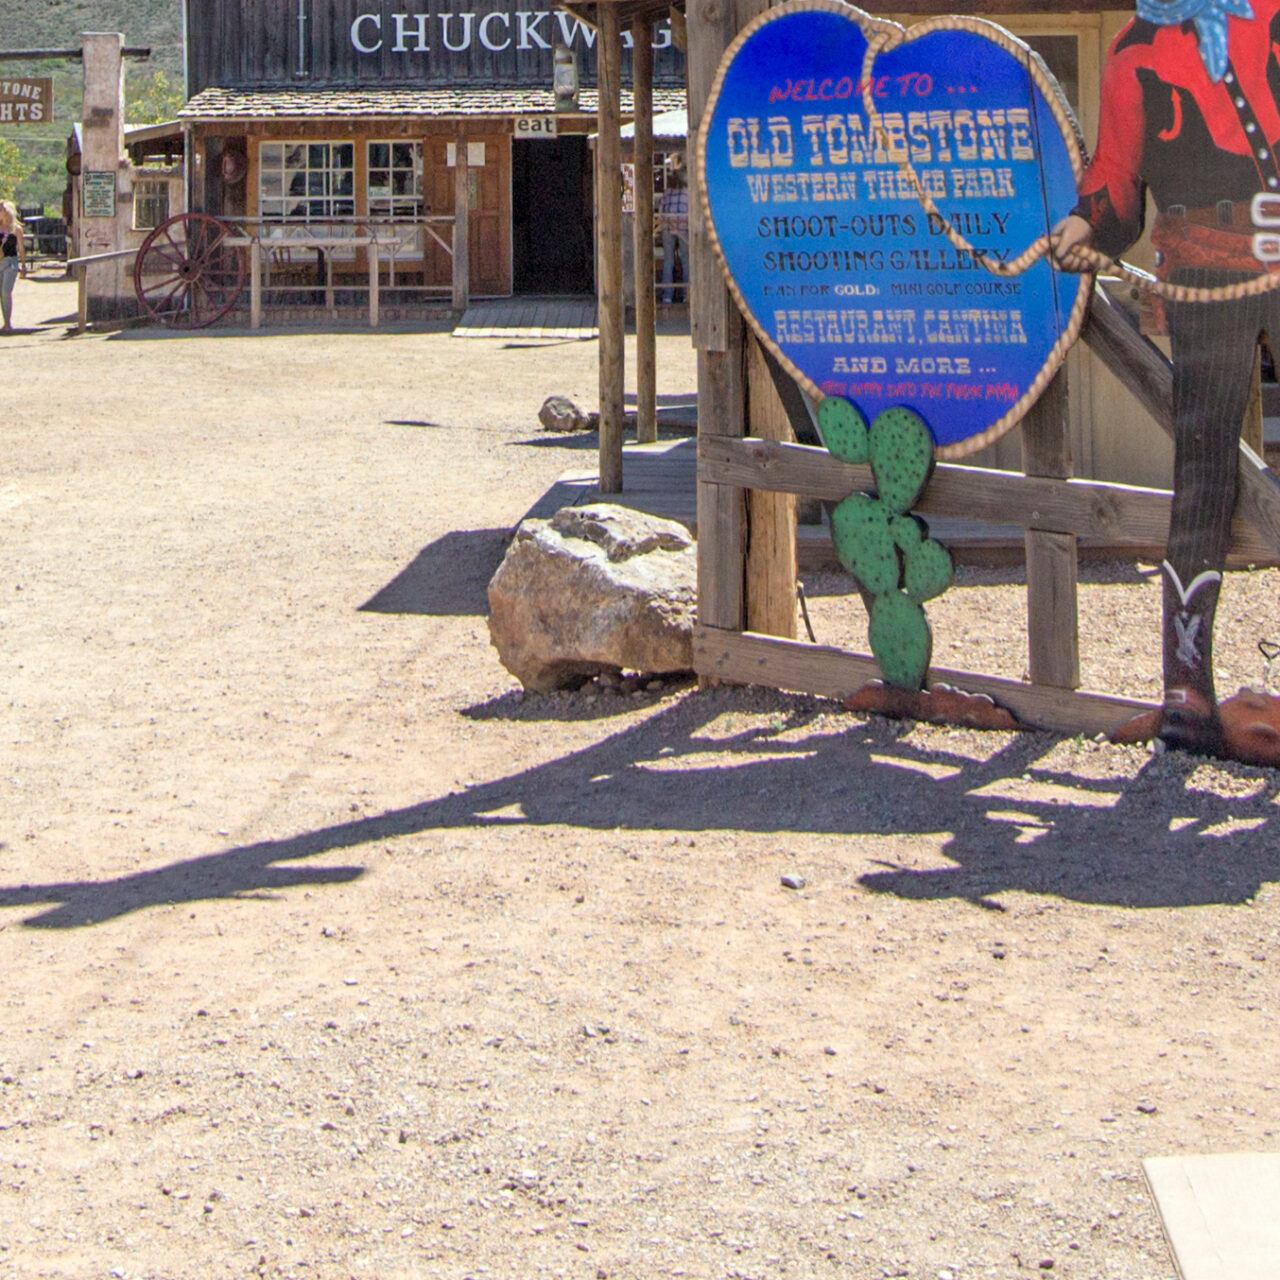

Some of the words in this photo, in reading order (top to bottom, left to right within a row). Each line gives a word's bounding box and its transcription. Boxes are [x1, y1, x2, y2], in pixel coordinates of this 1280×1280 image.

[769, 75, 890, 103] WELCOME
[897, 73, 933, 96] TO
[517, 118, 553, 133] eat
[727, 116, 794, 168] OLD
[802, 107, 1035, 166] TOMBSTONE
[746, 172, 857, 203] WESTERN
[863, 169, 947, 200] THEME
[951, 168, 1015, 199] PARK
[757, 213, 916, 239] SHOOT-OUTS
[926, 213, 1011, 236] DAILY
[763, 249, 885, 271] SHOOTING
[889, 248, 1012, 271] GALLERY
[800, 284, 830, 297] FOR
[891, 283, 923, 297] MINI
[926, 283, 962, 297] GOLF
[965, 282, 1022, 297] COURSE
[924, 309, 1028, 344] CANTINA
[832, 356, 887, 375] AND
[895, 357, 972, 375] MORE
